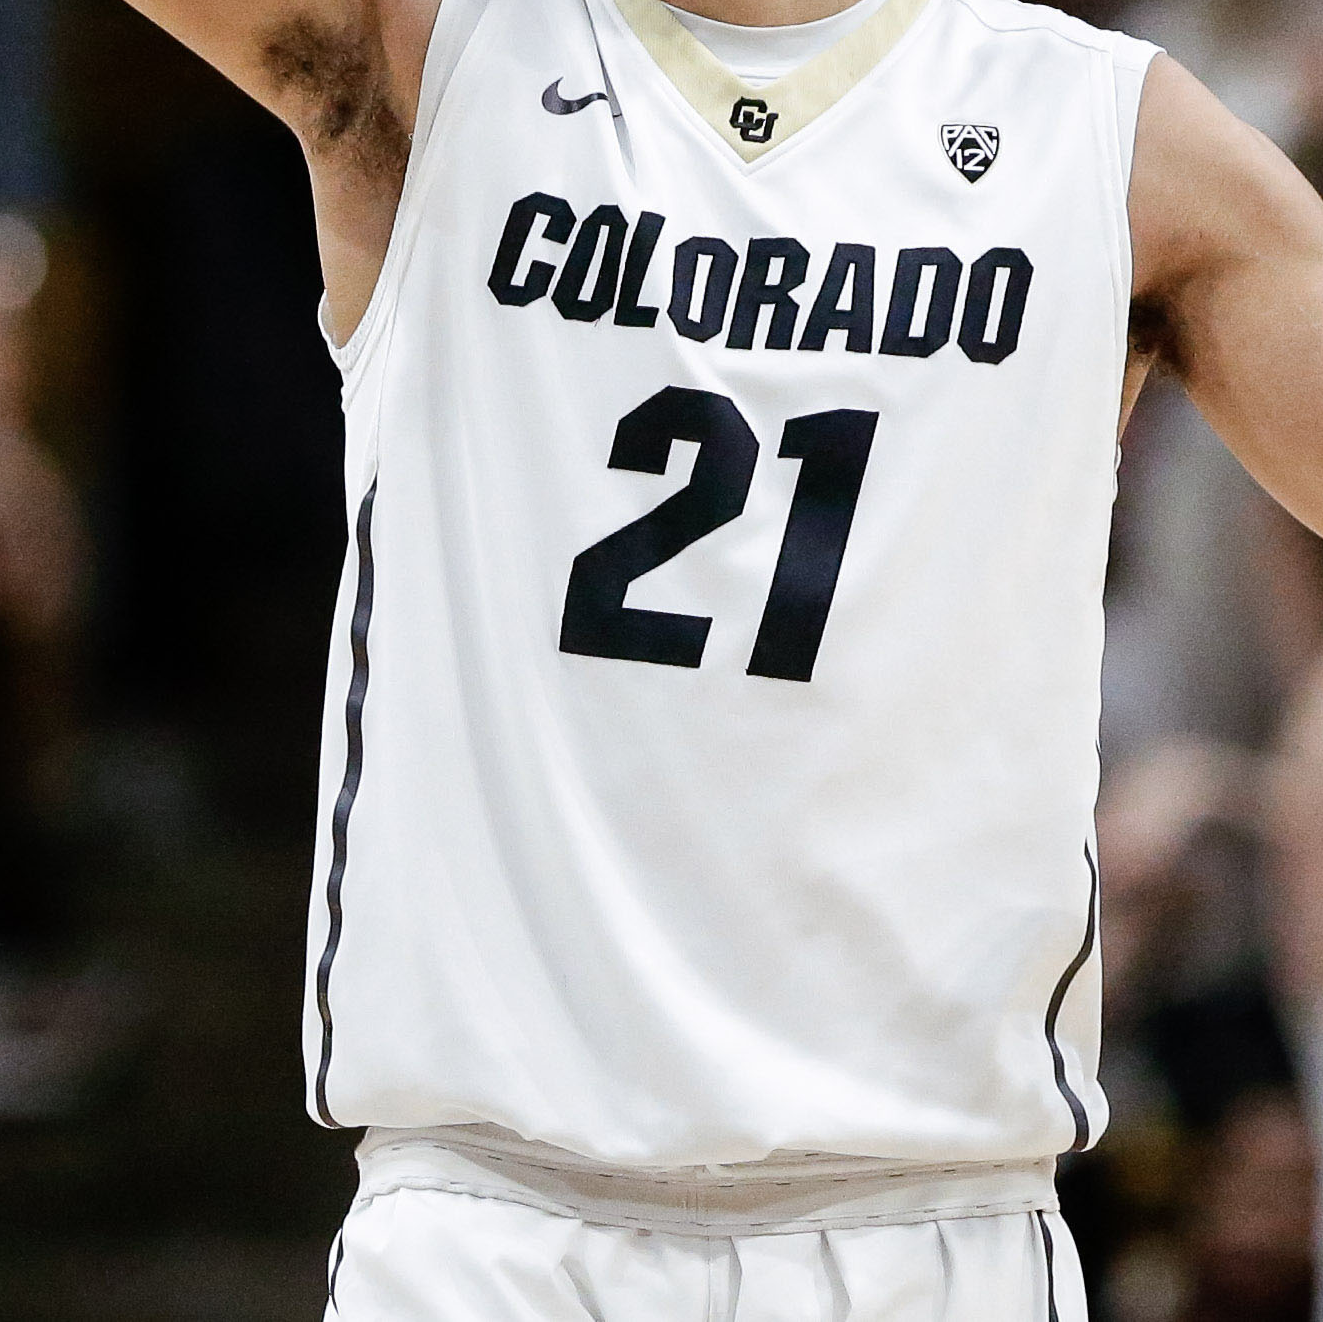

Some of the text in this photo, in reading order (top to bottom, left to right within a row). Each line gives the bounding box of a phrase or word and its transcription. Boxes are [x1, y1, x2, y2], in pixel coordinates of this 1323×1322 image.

[942, 125, 998, 160] PAC
[955, 147, 985, 172] 12
[487, 191, 1034, 366] COLORADO
[558, 384, 880, 683] 21
